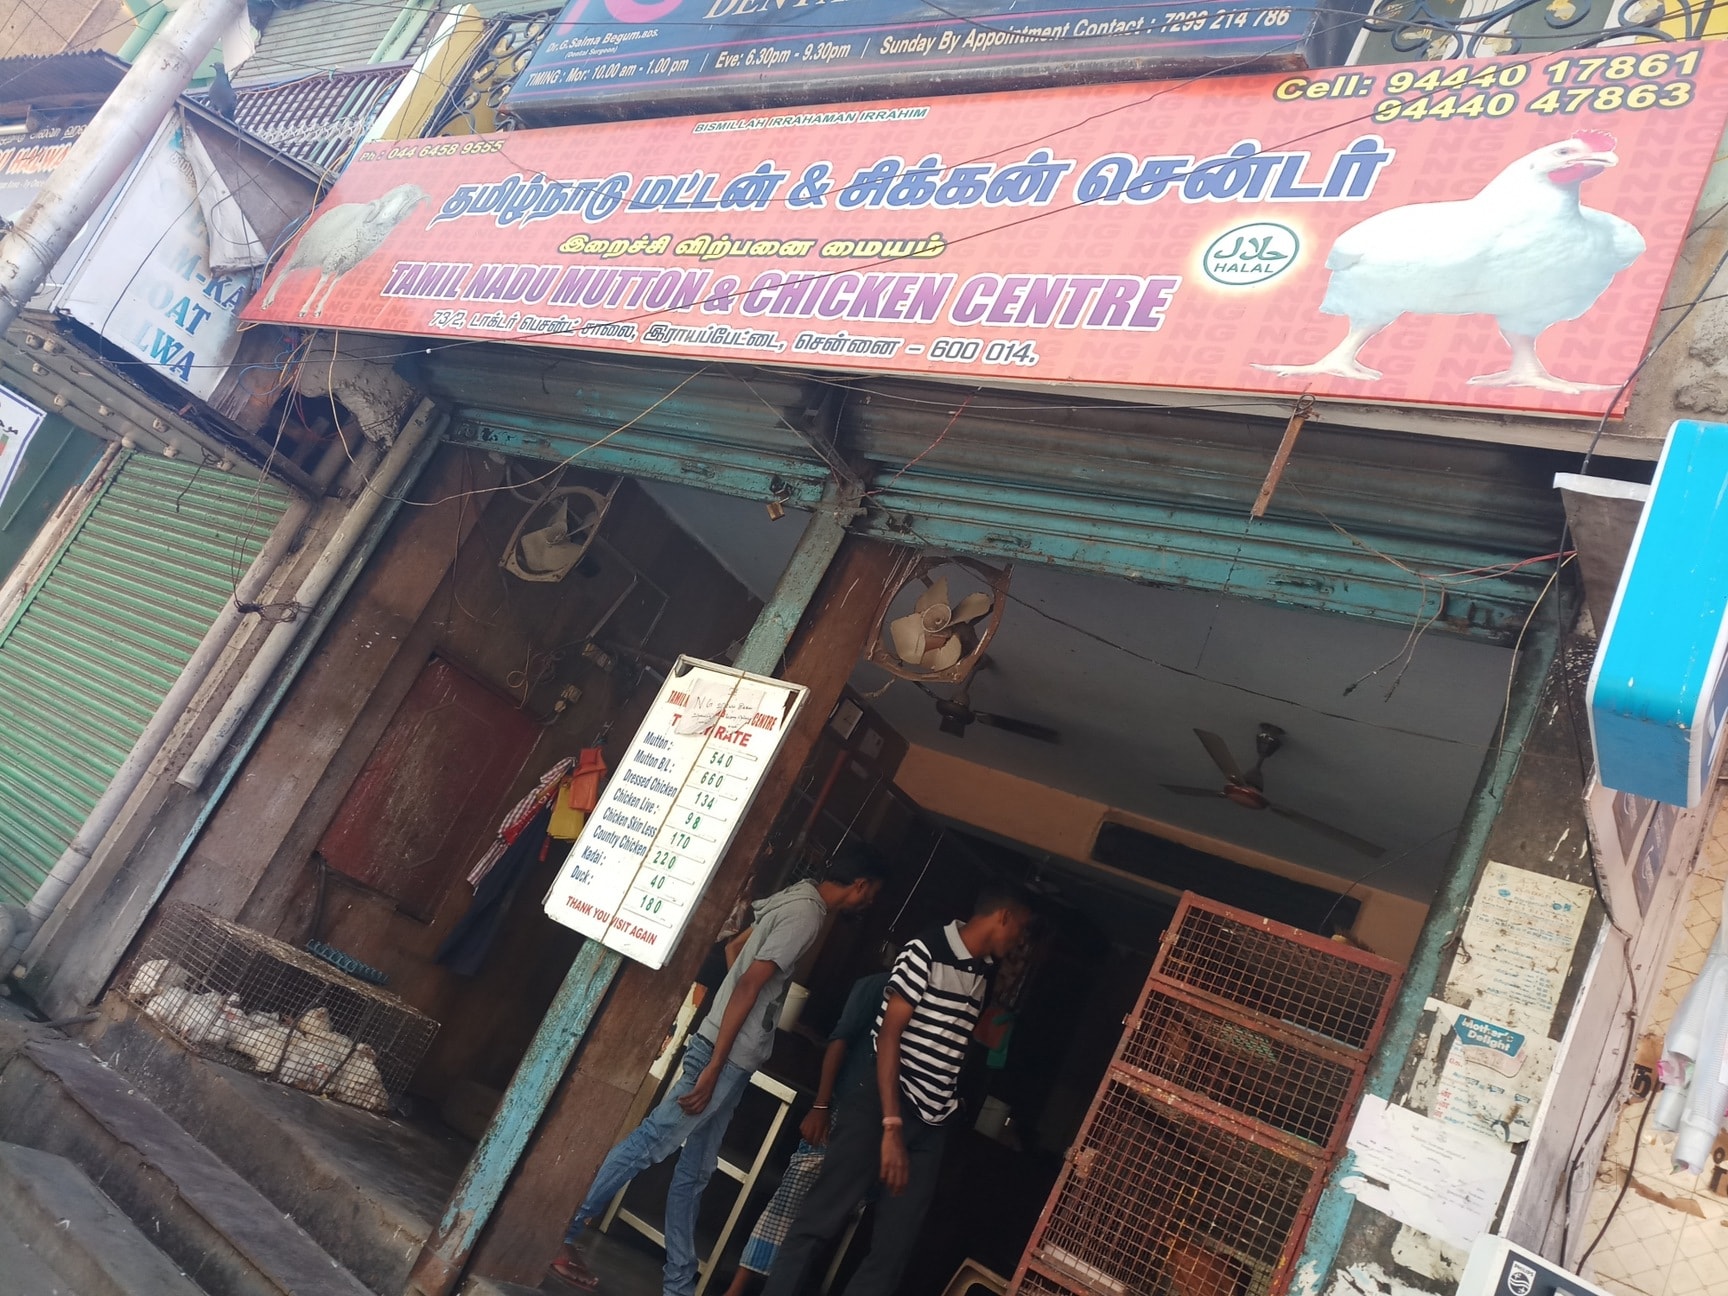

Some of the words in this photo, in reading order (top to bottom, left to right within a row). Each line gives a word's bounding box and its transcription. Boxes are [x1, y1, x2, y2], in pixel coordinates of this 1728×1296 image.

[525, 69, 561, 87] TIMING
[591, 63, 621, 80] 10.00
[619, 65, 637, 77] am
[646, 57, 670, 75] 1.00
[669, 58, 690, 76] pm
[714, 51, 742, 69] Eve:
[743, 46, 791, 67] 6.30pm
[802, 41, 852, 64] 9.30pm
[880, 33, 936, 56] Sunday
[937, 31, 962, 52] By
[962, 20, 1070, 51] Appointment
[1072, 17, 1145, 38] Contact
[1208, 9, 1249, 31] 214
[1274, 77, 1374, 101] Cell:
[1386, 61, 1528, 94] 94440
[1546, 48, 1703, 84] 17861
[694, 117, 767, 134] BISMILLAH
[768, 112, 856, 130] IRRAHAMAN
[859, 107, 929, 123] IRRAHIM
[1373, 90, 1516, 124] 94440
[1529, 80, 1695, 116] 47863
[387, 146, 417, 160] 044
[418, 144, 458, 158] 6458
[460, 139, 505, 155] 9555
[427, 174, 631, 229] தமிழ்நாடு
[627, 161, 790, 212] மட்டன்
[788, 162, 835, 210] &
[837, 148, 1075, 211] சிக்கன்
[559, 233, 671, 259] இறைச்சி
[675, 233, 816, 260] விற்பனை
[820, 233, 947, 259] மையம்
[1213, 262, 1275, 273] HALAL
[382, 262, 473, 299] TAMIL
[461, 263, 558, 302] NADU
[550, 266, 712, 310] MUTTON
[702, 276, 741, 314] &
[743, 271, 956, 322] CHICKEN
[951, 274, 1181, 331] CENTRE
[470, 311, 519, 331] டாக்டர்
[793, 332, 902, 357] சென்னை
[929, 338, 982, 361] 600
[713, 725, 753, 748] RATE
[750, 712, 778, 731] CENTRE
[633, 749, 659, 769] Mutton
[700, 771, 724, 788] 660
[643, 731, 669, 749] Mutton
[710, 751, 734, 768] 540
[613, 788, 640, 809] Chicken
[639, 797, 655, 814] Live
[685, 812, 701, 830] 98
[623, 769, 650, 789] Dressed
[649, 777, 678, 798] Chicken
[694, 792, 715, 811] 134
[593, 825, 620, 848] Country
[618, 834, 647, 857] Chicken
[652, 850, 677, 870] 220
[602, 807, 629, 828] Chicken
[627, 815, 643, 833] Skin
[640, 822, 658, 838] Less
[670, 831, 691, 850] 170
[581, 845, 603, 865] Kadai
[650, 875, 666, 890] 40
[570, 865, 589, 884] Duck
[640, 894, 662, 914] 180
[566, 896, 593, 916] THANK
[592, 906, 610, 923] YOU
[629, 925, 657, 945] AGAIN
[1467, 1030, 1511, 1051] Delight
[1513, 1263, 1536, 1277] PHILIPS
